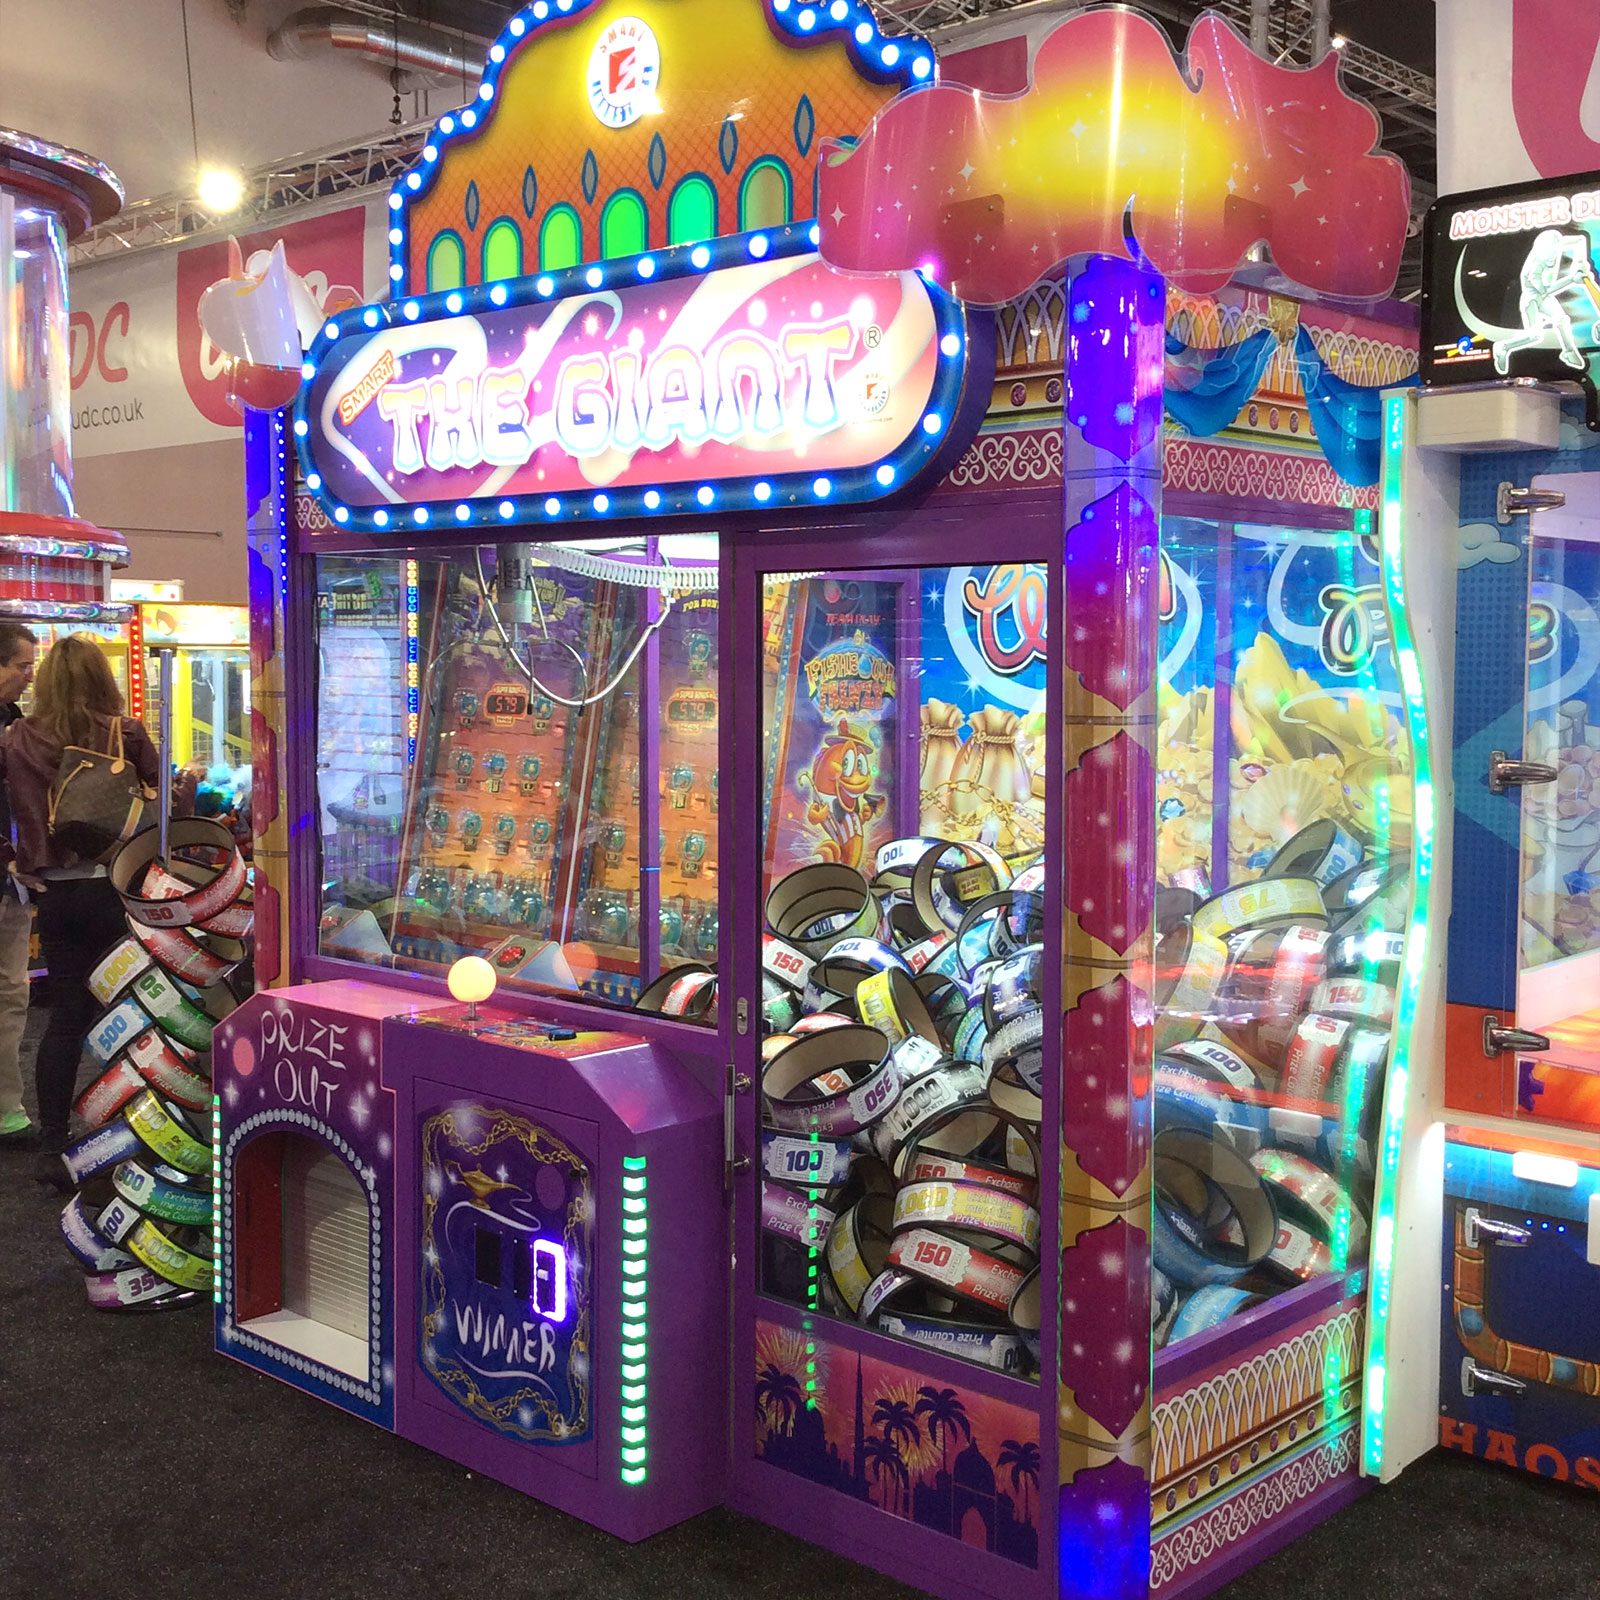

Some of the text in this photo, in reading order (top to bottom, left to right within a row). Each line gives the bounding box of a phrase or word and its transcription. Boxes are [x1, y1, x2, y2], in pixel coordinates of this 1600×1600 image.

[1450, 196, 1571, 240] MONSTER
[338, 350, 394, 425] SMART
[377, 367, 532, 474] THE
[553, 322, 860, 459] GIANT
[701, 598, 719, 608] BON
[142, 907, 174, 921] 150
[772, 951, 804, 974] 150
[97, 1014, 128, 1053] 500
[260, 1009, 350, 1070] PRIZE
[1202, 1047, 1242, 1073] 100
[1288, 1047, 1304, 1075] Prize
[274, 1057, 340, 1117] OUT
[1160, 1064, 1208, 1086] Exchange
[864, 1071, 893, 1112] 350
[1155, 1084, 1210, 1108] rize Counter
[786, 1150, 823, 1172] 100
[149, 1205, 173, 1218] Prize
[786, 1196, 809, 1212] Exch
[103, 1206, 125, 1240] 100
[768, 1216, 793, 1232] Prize
[954, 1213, 981, 1226] Prize
[983, 1217, 1018, 1233] Counter
[914, 1241, 952, 1268] 150
[972, 1284, 998, 1301] Prize
[451, 1298, 557, 1374] WINNER
[914, 1328, 984, 1345] Prize Counter
